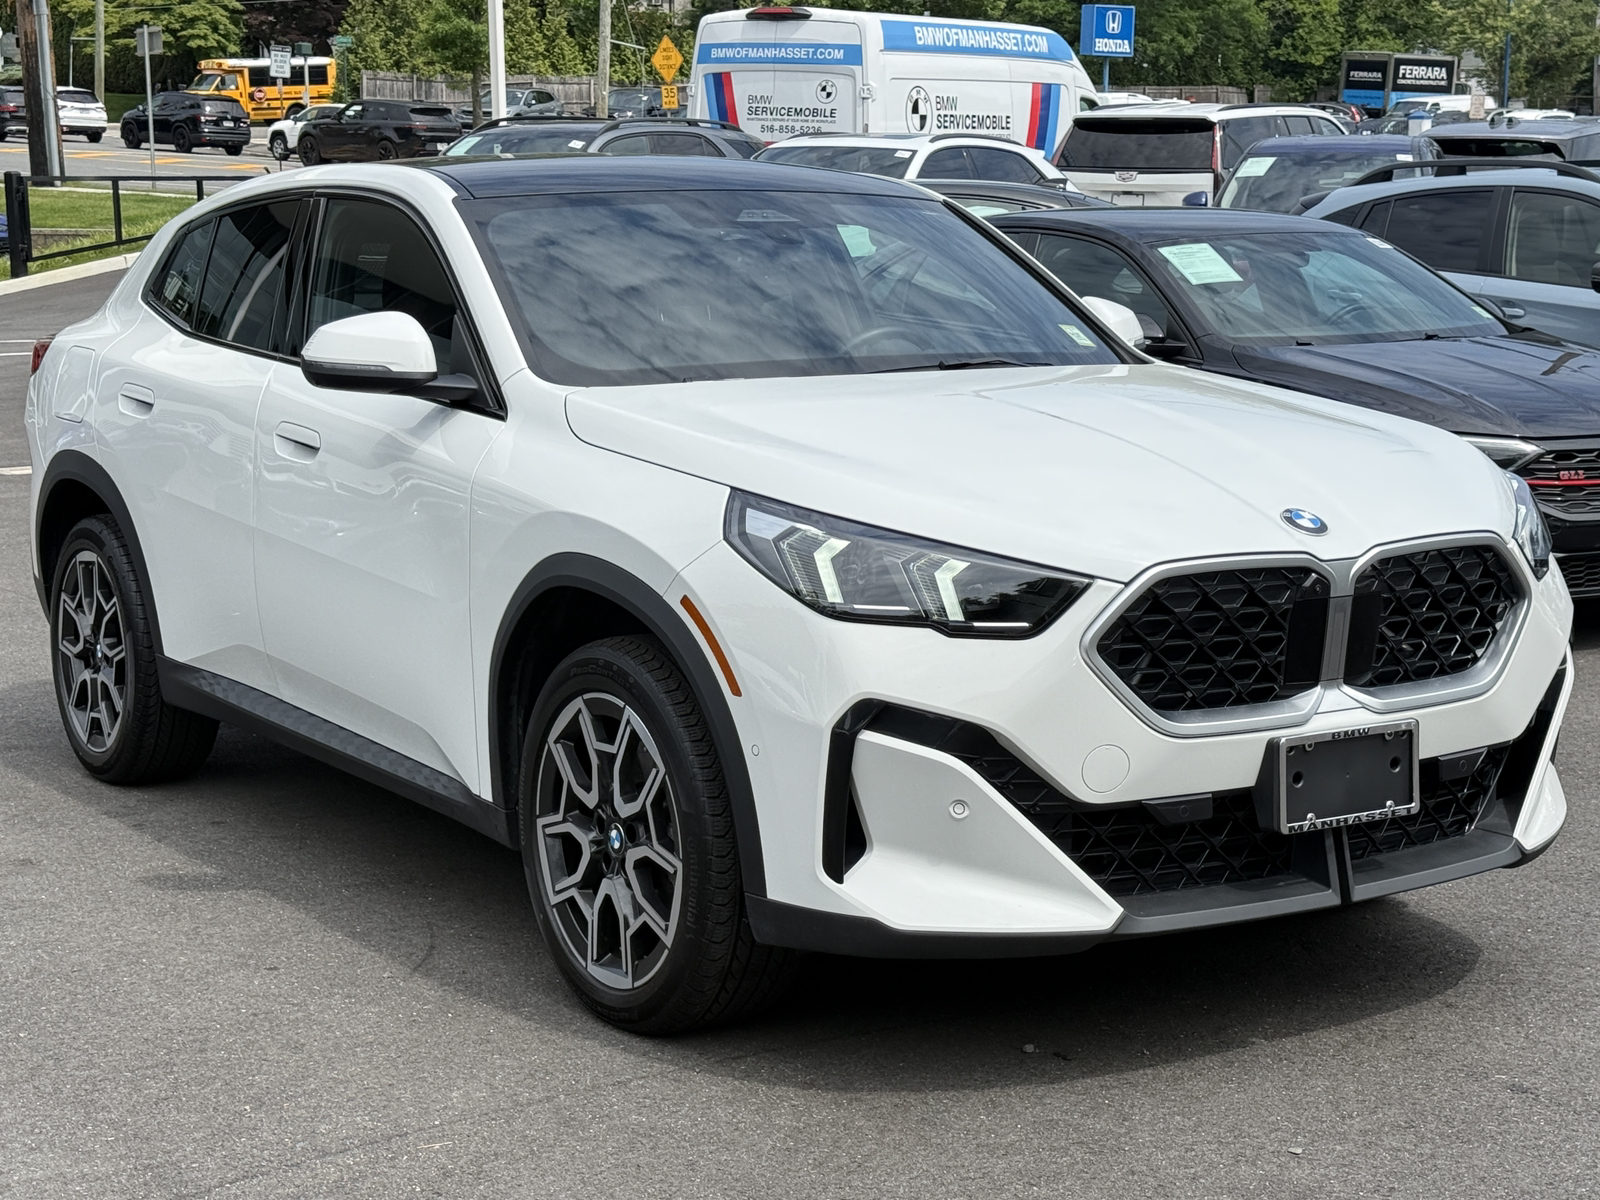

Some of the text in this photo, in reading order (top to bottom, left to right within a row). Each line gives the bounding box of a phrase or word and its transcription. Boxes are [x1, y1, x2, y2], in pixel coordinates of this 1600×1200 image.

[914, 26, 1049, 53] BMWOFMANHASSET.COM
[1094, 38, 1131, 53] HONDA
[710, 47, 844, 60] BMWOFMANHASSET.COM
[1349, 71, 1382, 79] FERRARA
[1399, 65, 1448, 80] FERRARA
[663, 87, 676, 99] 35
[747, 94, 773, 105] BMW
[935, 95, 958, 111] BMW
[746, 106, 838, 118] SERVICEMOBILE
[936, 114, 1011, 130] SERVICEMOBILE
[760, 124, 822, 134] 516-858-5236
[1559, 470, 1585, 480] GLI
[1331, 728, 1371, 740] BMW
[1288, 807, 1414, 834] MANHASSET
